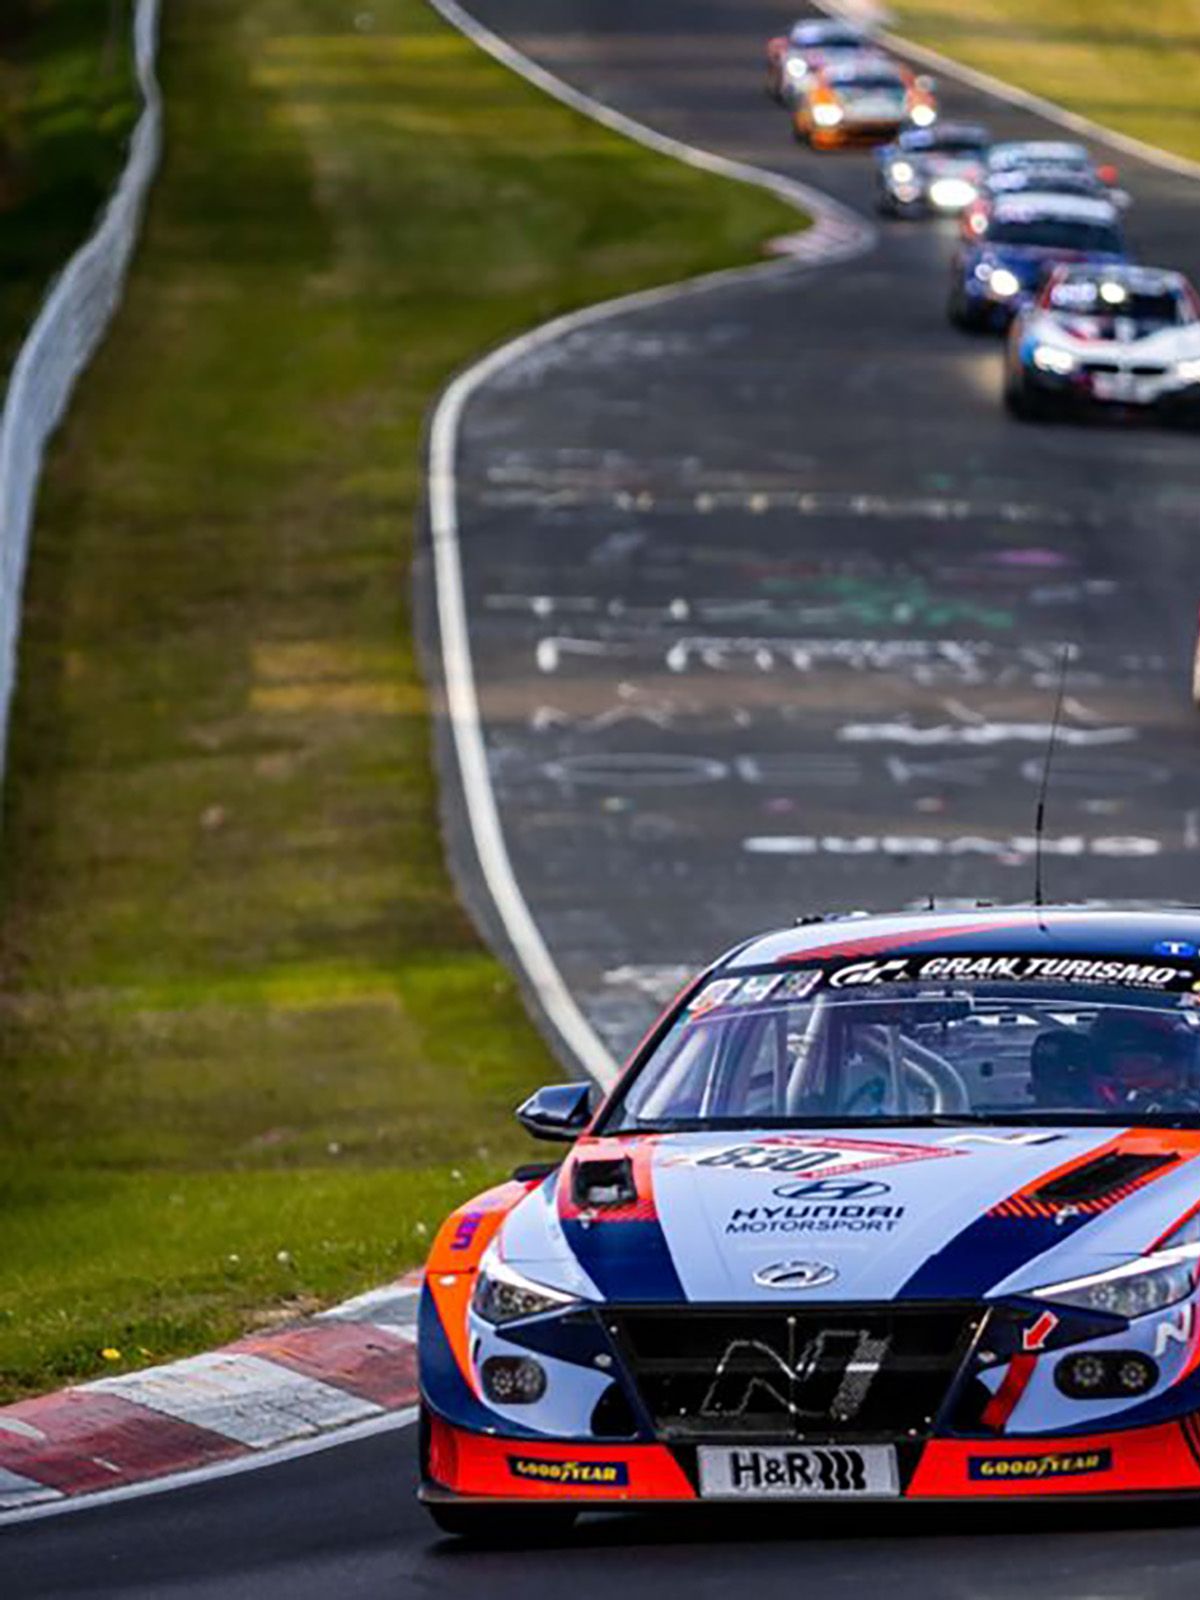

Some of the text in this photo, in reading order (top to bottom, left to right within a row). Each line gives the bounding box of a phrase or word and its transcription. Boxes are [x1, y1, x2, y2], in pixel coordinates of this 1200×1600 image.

[919, 957, 1021, 978] GRAN
[1023, 958, 1178, 984] TURISMO
[697, 1146, 841, 1172] 830
[731, 1206, 905, 1221] HYUNDAI
[725, 1220, 898, 1234] MOTORSPORT
[516, 1460, 618, 1482] GOODYEAR
[730, 1451, 815, 1487] H&R
[979, 1454, 1100, 1477] GOODYEAR
